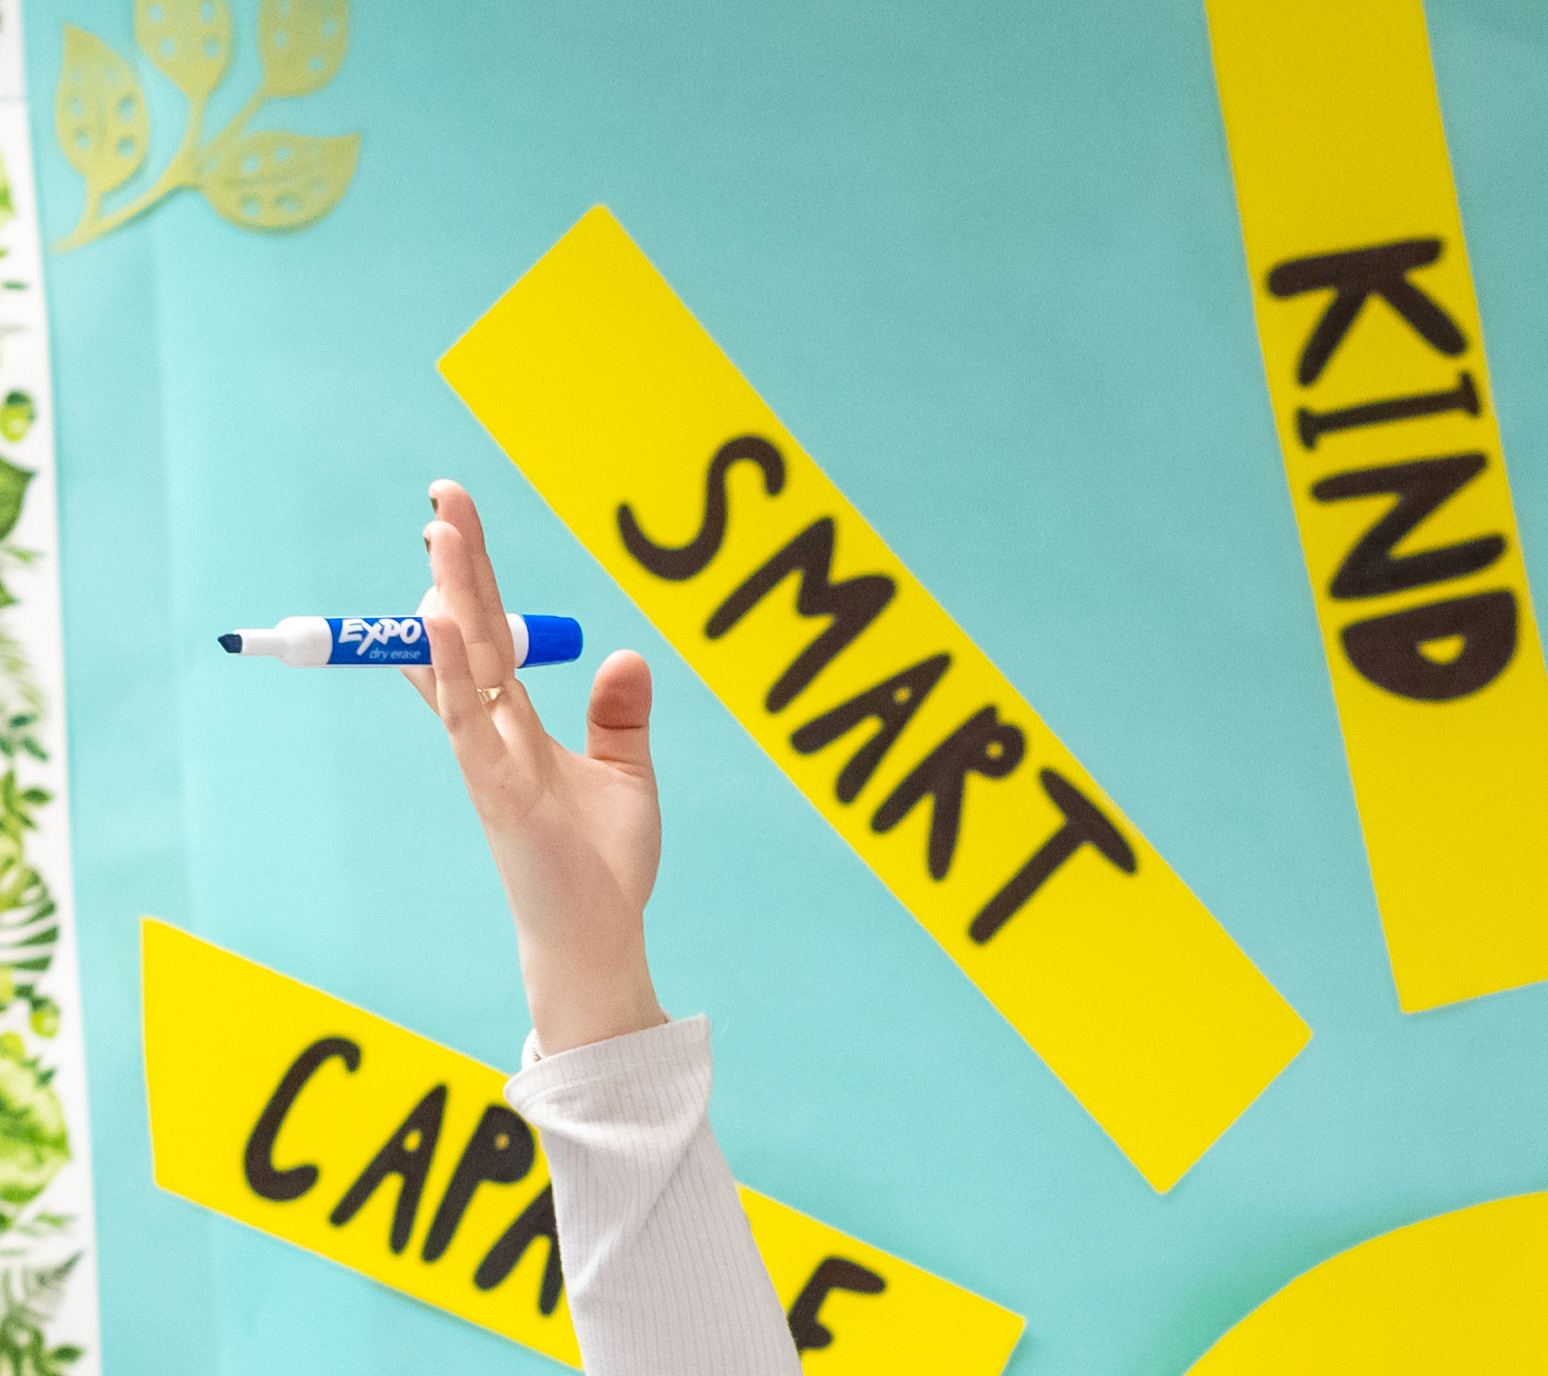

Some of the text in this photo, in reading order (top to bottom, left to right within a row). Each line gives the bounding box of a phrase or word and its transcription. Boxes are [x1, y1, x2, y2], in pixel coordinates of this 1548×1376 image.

[1264, 235, 1520, 705] KIND
[338, 618, 422, 656] EXPO
[369, 648, 421, 661] dry erase
[615, 434, 1139, 947] SMART
